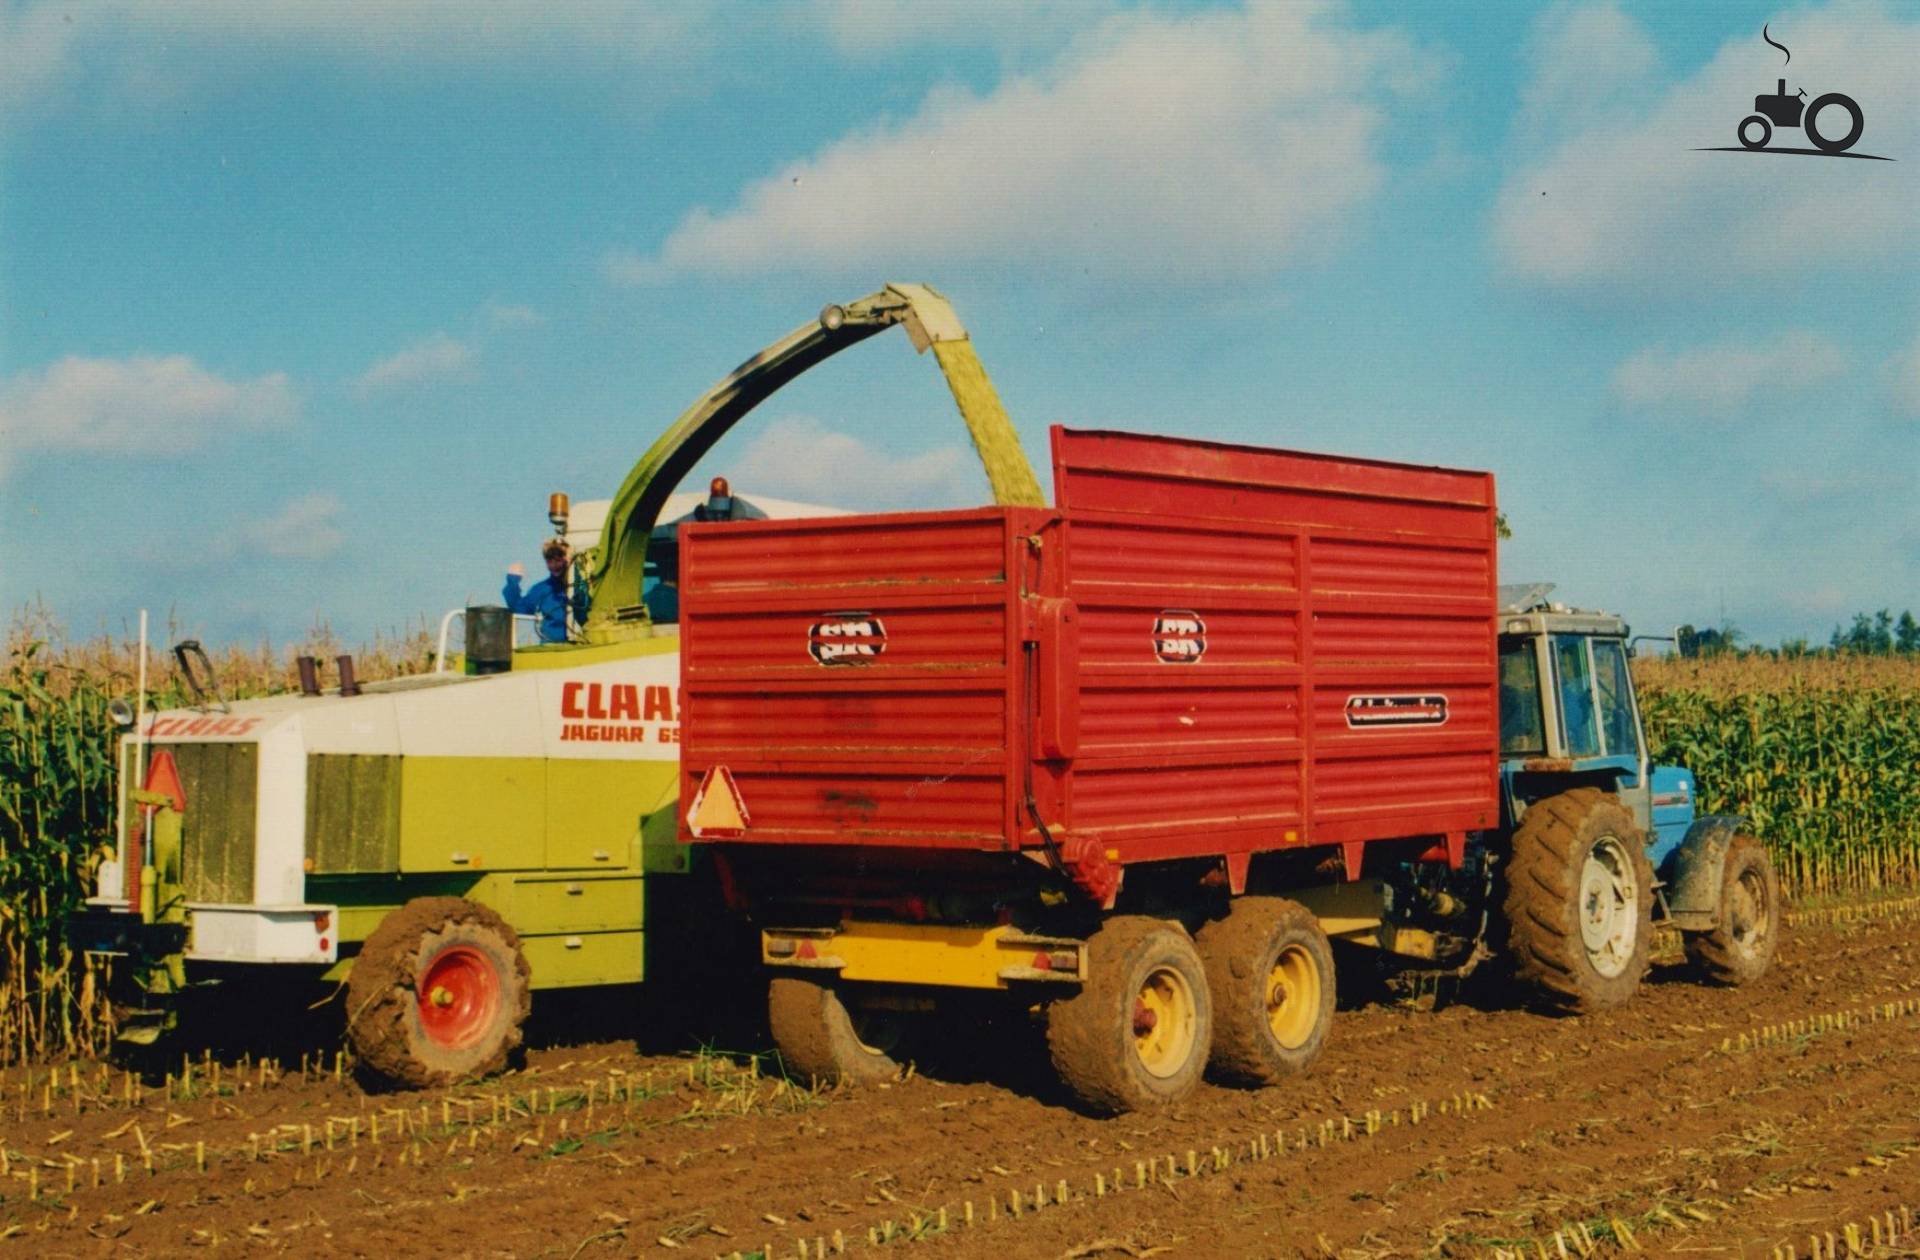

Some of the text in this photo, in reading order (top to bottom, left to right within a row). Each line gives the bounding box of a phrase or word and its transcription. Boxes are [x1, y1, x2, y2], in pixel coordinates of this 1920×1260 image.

[561, 681, 680, 721] CLAA
[143, 717, 263, 737] CLAAS
[560, 724, 644, 742] JAGUAR
